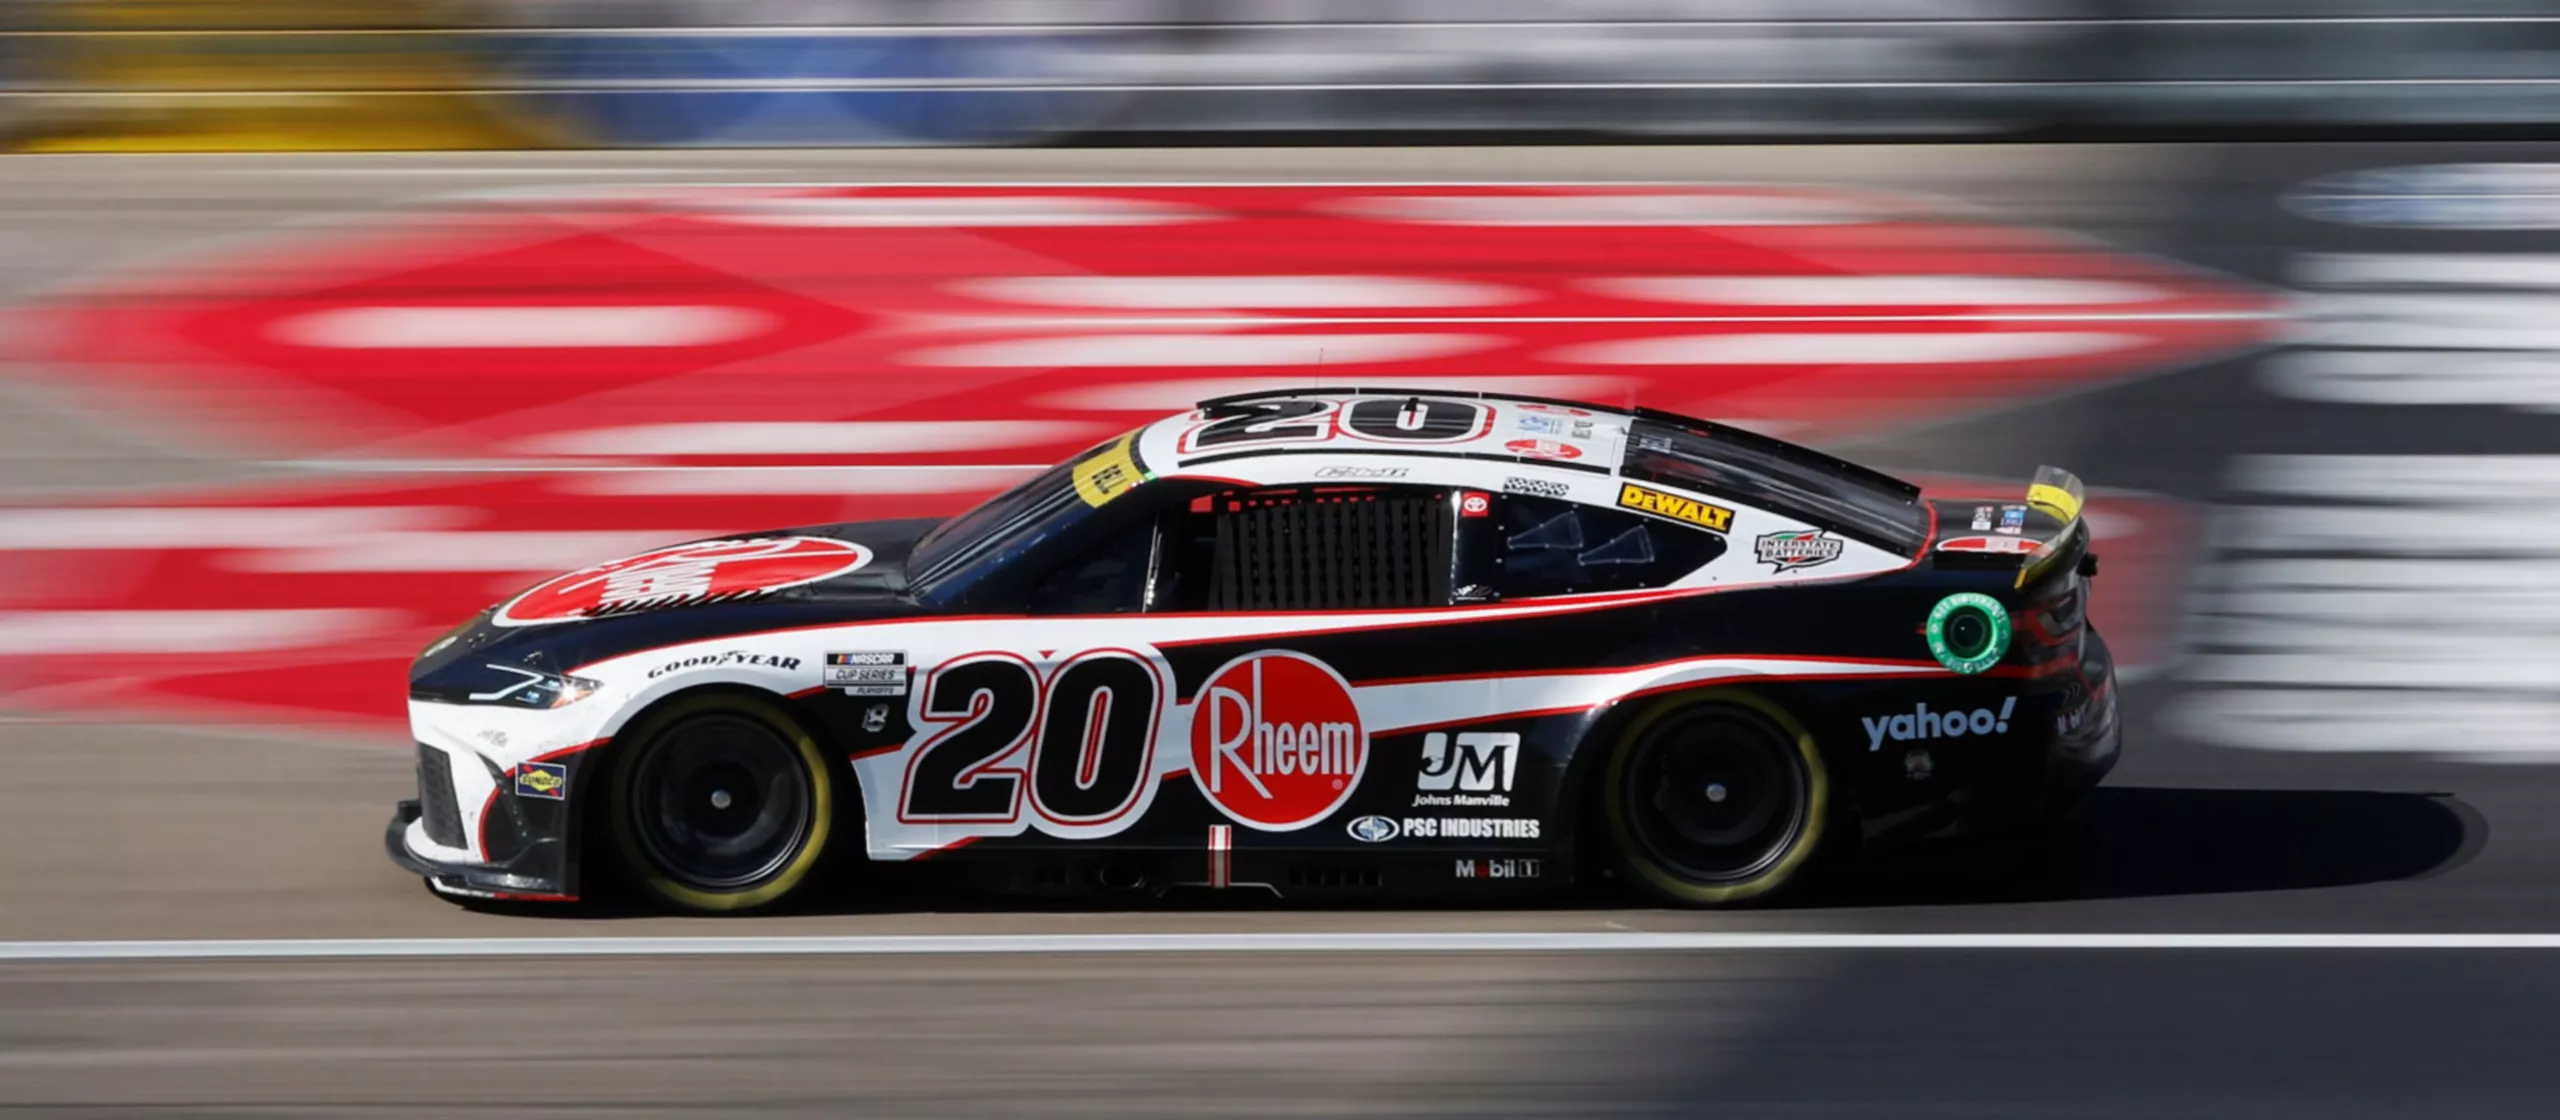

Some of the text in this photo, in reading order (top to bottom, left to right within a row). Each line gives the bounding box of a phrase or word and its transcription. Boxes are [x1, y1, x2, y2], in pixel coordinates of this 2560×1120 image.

[1180, 399, 1496, 453] 20
[1761, 539, 1837, 550] INTERSTATE
[1765, 549, 1835, 558] BATTERIES
[851, 653, 895, 665] NASCAR
[836, 669, 896, 680] CUP SERIES
[1210, 658, 1355, 799] Rheem
[1861, 696, 2018, 751] yahoo!
[897, 647, 1164, 826] 20
[1418, 732, 1521, 792] JM
[1412, 795, 1510, 807] Johns Manville
[1403, 818, 1541, 838] PSC INDUSTRIES
[1455, 859, 1516, 878] Mobil
